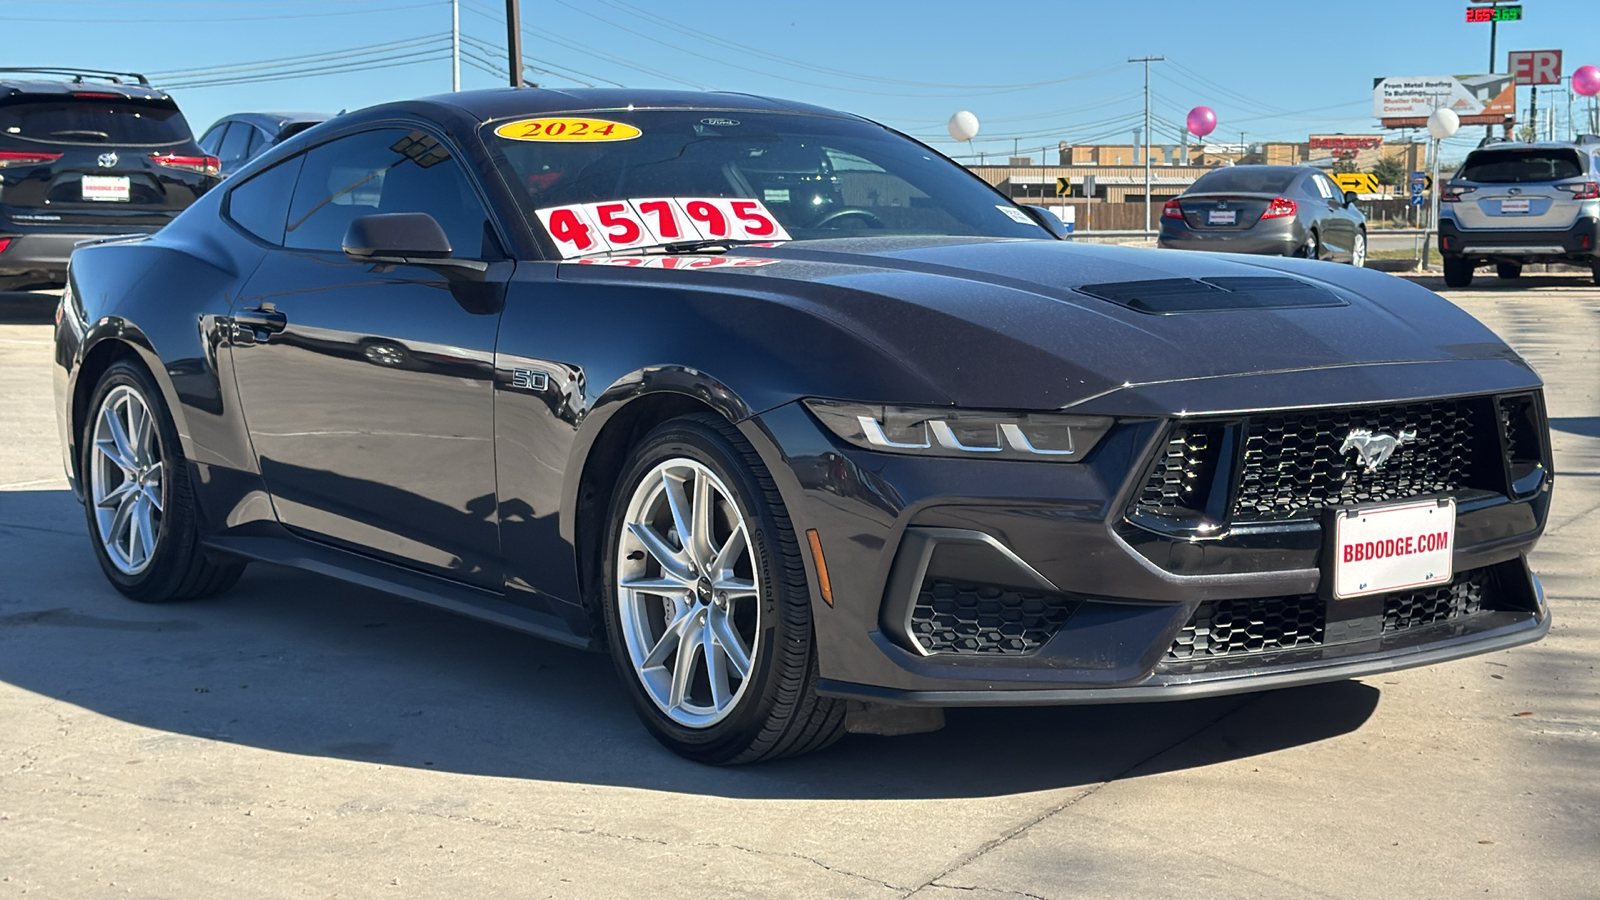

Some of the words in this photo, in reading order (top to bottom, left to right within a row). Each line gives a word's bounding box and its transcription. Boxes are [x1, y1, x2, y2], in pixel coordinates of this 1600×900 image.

[1510, 52, 1558, 83] ER
[521, 122, 615, 137] 2024
[1309, 138, 1382, 149] EMERGENCY
[549, 201, 778, 251] 45795
[1343, 531, 1448, 563] BBDODGE.COM
